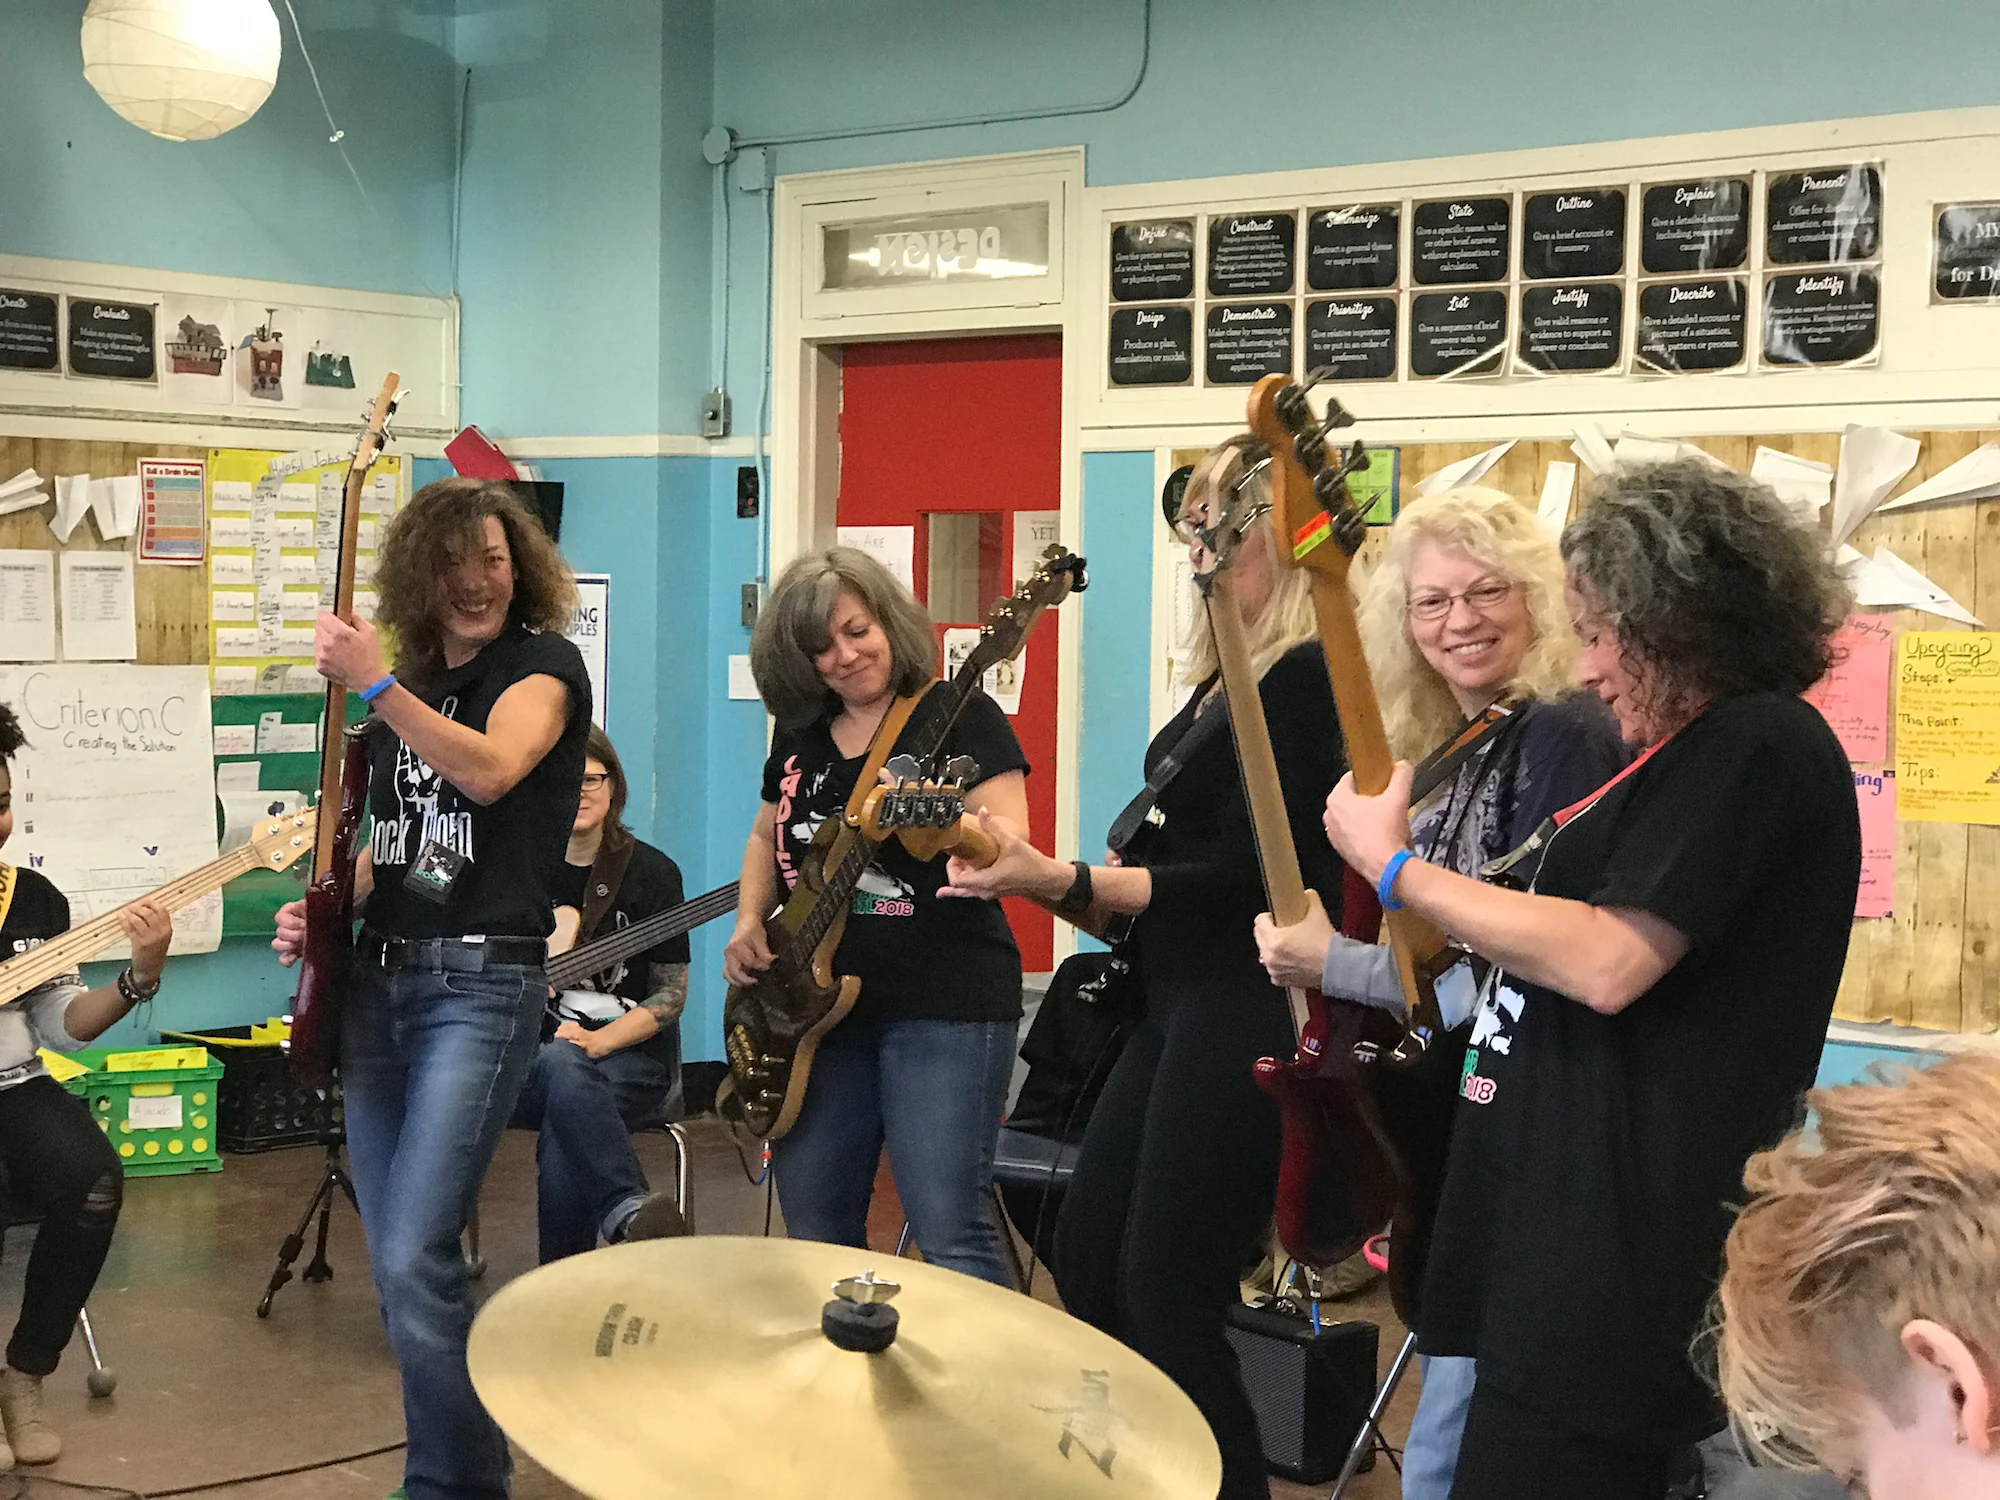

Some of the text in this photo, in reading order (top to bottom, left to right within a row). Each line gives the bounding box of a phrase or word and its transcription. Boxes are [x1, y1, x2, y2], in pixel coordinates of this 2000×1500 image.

[1800, 175, 1846, 194] Present
[1555, 196, 1595, 213] Outline
[1674, 187, 1717, 207] Explain
[1448, 204, 1475, 220] State
[1139, 226, 1169, 244] Define
[1230, 219, 1274, 235] Construct
[1950, 266, 1975, 283] for
[1669, 285, 1717, 304] Describe
[1795, 276, 1845, 297] Identify
[1446, 295, 1471, 311] List
[1552, 288, 1590, 309] Justify
[93, 305, 131, 320] Evaluate
[1136, 311, 1167, 328] Design
[1222, 307, 1278, 323] Demonstrate
[1327, 302, 1375, 320] Prioritize
[1031, 526, 1056, 540] YET
[1906, 636, 1993, 669] Upcycling
[1902, 663, 1944, 687] Steps:
[24, 672, 184, 736] Criterion C
[1898, 713, 1924, 727] The
[63, 731, 176, 755] Creating the Solution
[1902, 761, 1940, 786] Tips:
[371, 811, 413, 865] OCK
[28, 852, 44, 868] iv
[875, 900, 915, 917] 2018
